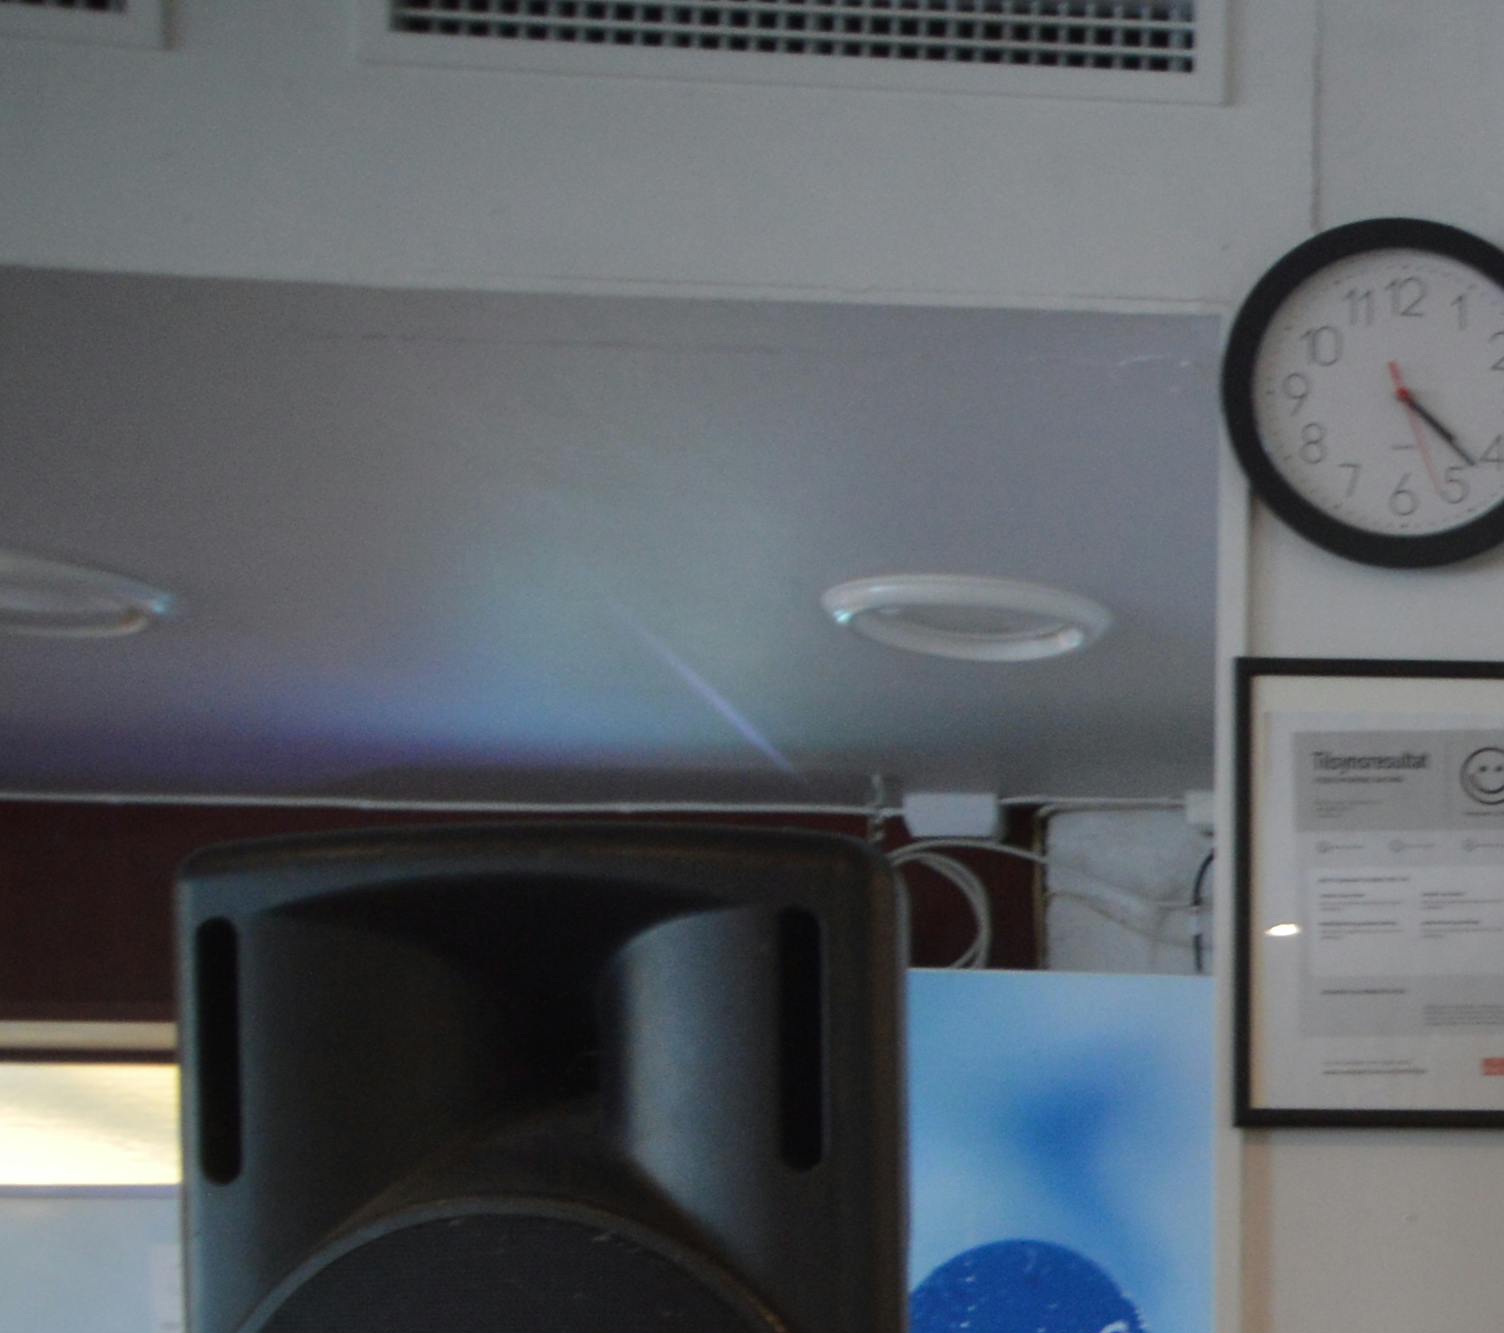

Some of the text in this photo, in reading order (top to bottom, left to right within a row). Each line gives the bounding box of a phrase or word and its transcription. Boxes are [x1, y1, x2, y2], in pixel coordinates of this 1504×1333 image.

[1346, 289, 1373, 327] 11
[1385, 276, 1426, 317] 12
[1450, 295, 1467, 330] 1
[1301, 325, 1342, 367] 10
[1283, 373, 1309, 417] 9
[1301, 423, 1326, 464] 8
[1479, 434, 1504, 471] 4
[1338, 462, 1362, 500] 7
[1390, 472, 1419, 516] 6
[1440, 466, 1469, 504] 5
